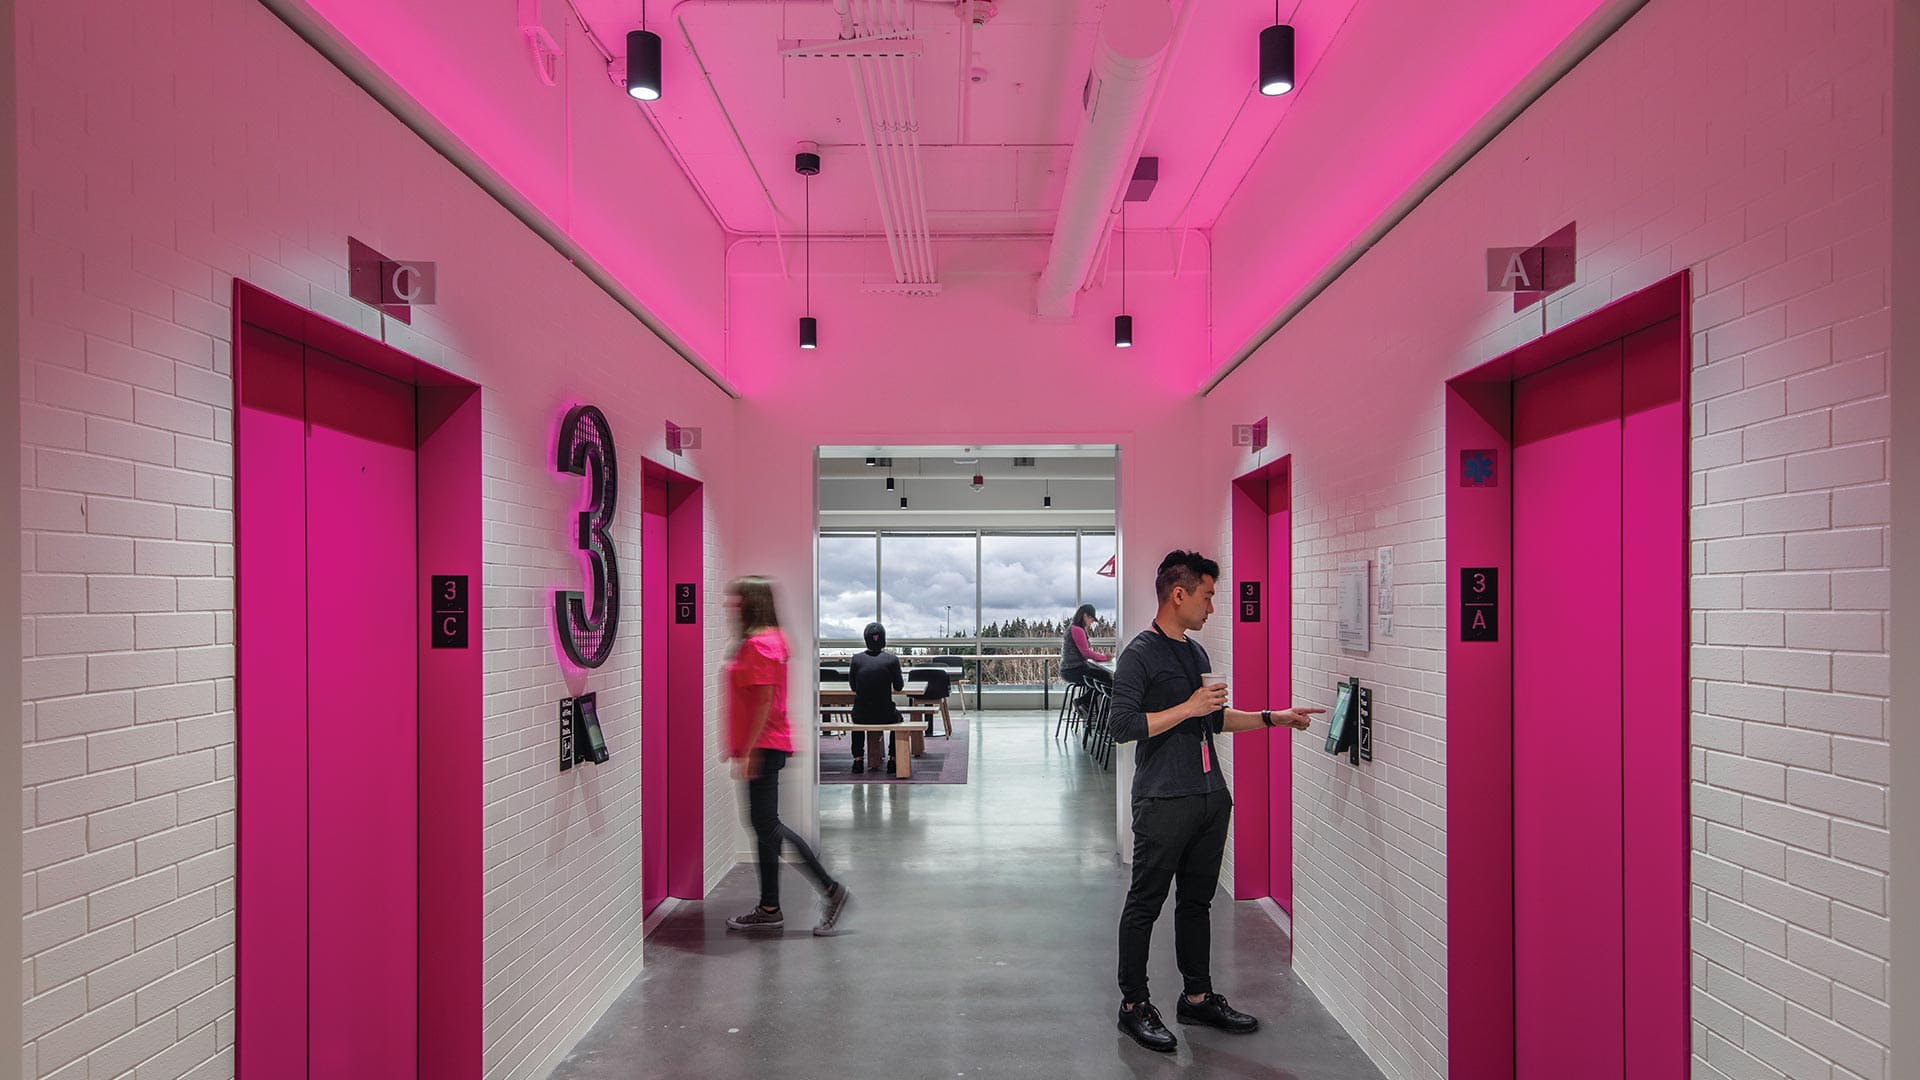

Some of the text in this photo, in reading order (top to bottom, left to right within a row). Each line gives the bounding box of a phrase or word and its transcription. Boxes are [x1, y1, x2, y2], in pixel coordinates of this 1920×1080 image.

[1501, 252, 1530, 287] A
[393, 266, 421, 300] C
[681, 430, 694, 447] D
[1238, 427, 1250, 444] B
[555, 405, 620, 669] 3
[444, 581, 456, 600] 3
[682, 586, 690, 598] 3
[1246, 584, 1254, 596] 3
[1473, 573, 1486, 593] 3
[682, 606, 690, 617] D
[1246, 604, 1254, 616] B
[1472, 609, 1486, 630] A
[443, 617, 456, 636] C
